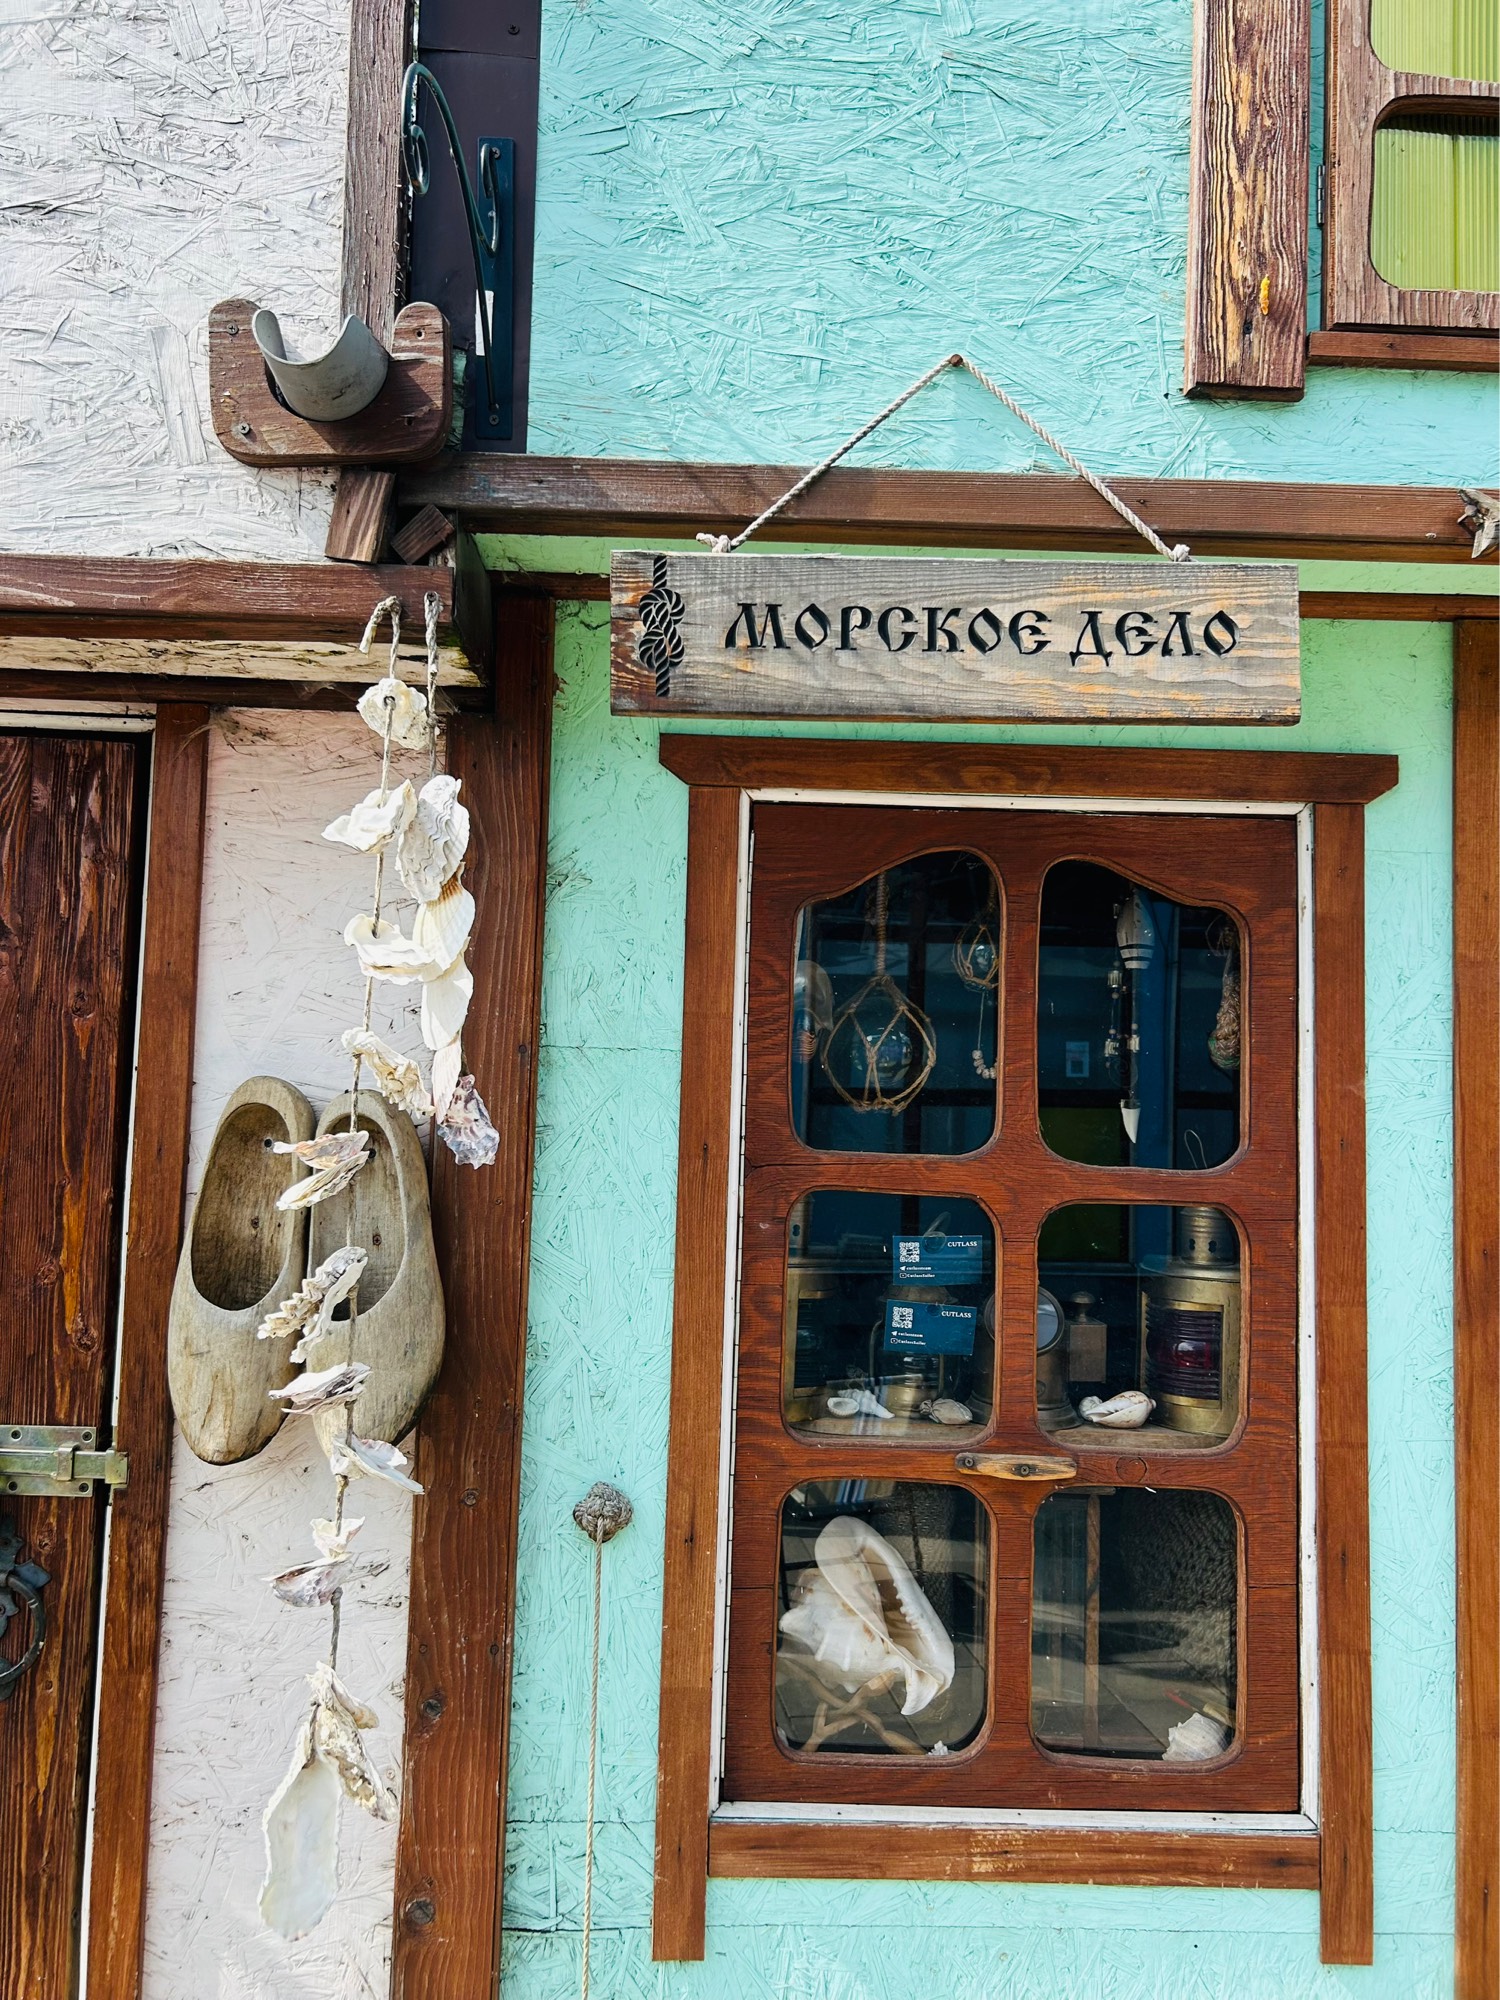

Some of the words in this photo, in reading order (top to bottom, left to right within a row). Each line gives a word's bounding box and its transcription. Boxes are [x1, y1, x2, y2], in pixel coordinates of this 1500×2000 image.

[724, 602, 1052, 655] МОРСКОЕ
[1069, 609, 1240, 667] ДЕЛО
[941, 1310, 971, 1318] CUTLASS
